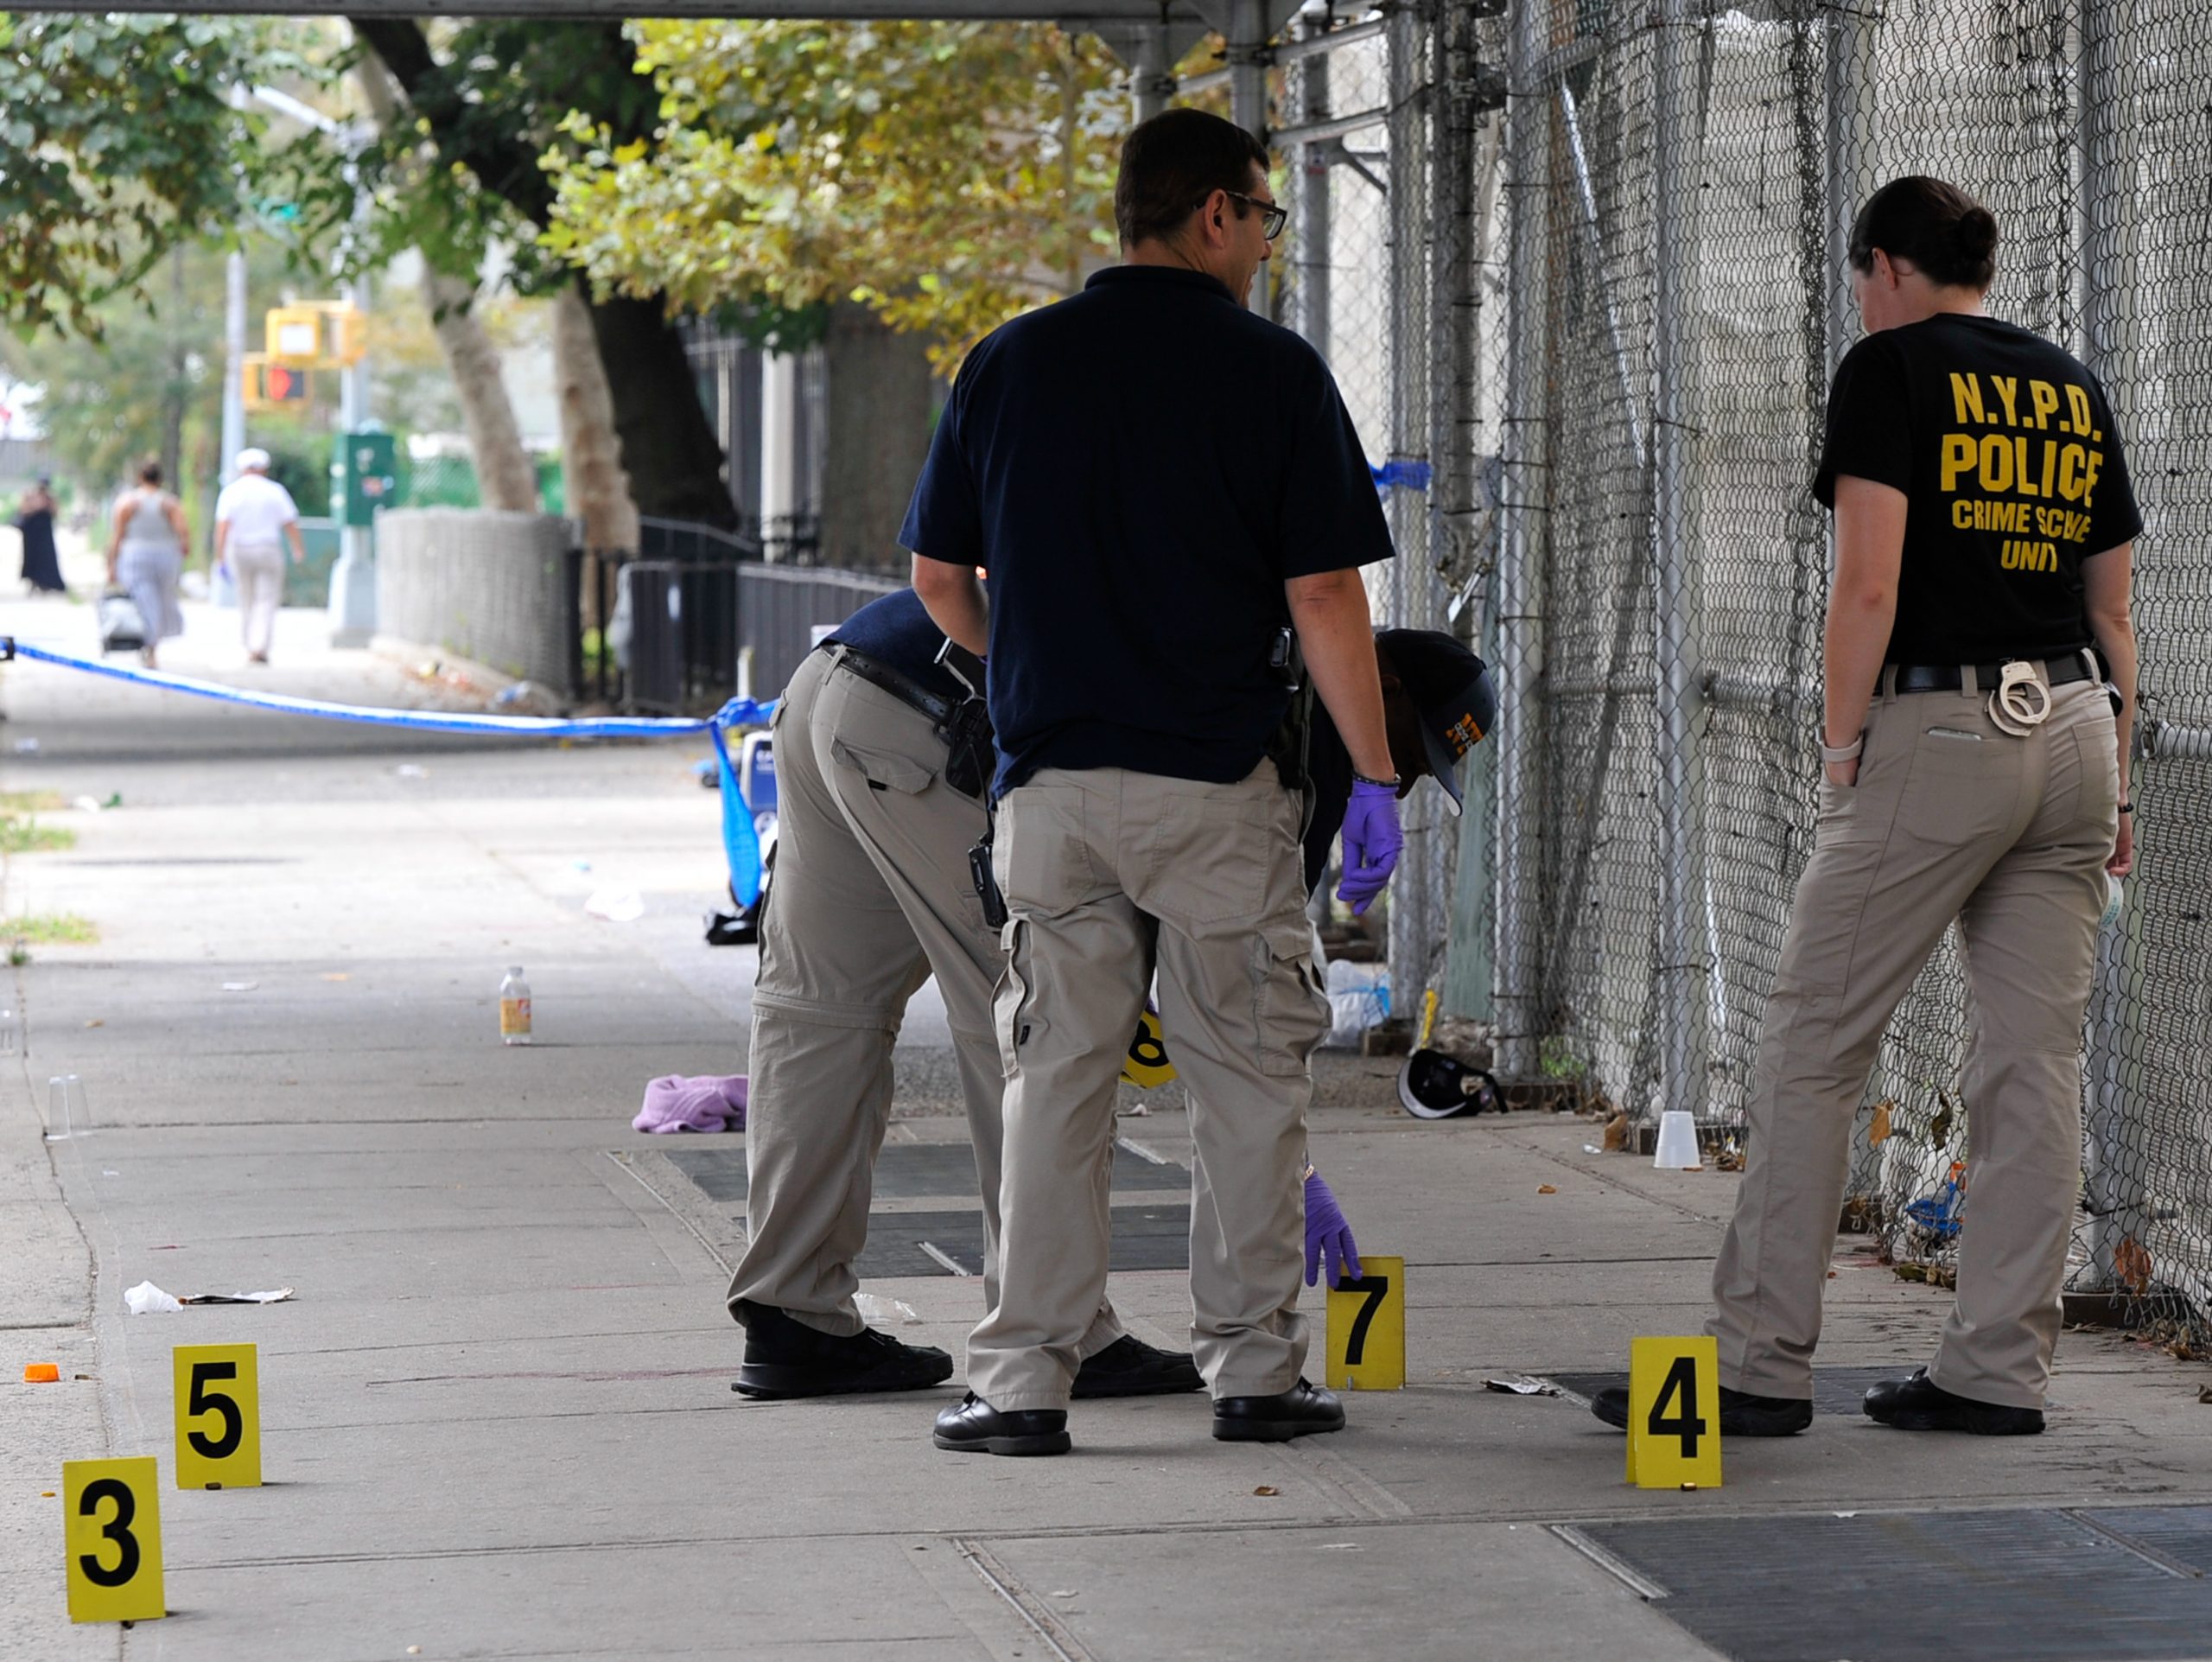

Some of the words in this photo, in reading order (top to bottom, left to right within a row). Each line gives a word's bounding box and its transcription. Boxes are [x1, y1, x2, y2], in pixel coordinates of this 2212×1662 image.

[1949, 373, 2102, 443] N.Y.P.D.
[1941, 433, 2102, 508] POLICE
[1952, 500, 2031, 533] CRIME
[1333, 1276, 1389, 1366] 7
[188, 1361, 243, 1460] 5
[1648, 1357, 1707, 1458] 4
[79, 1478, 140, 1588] 3
